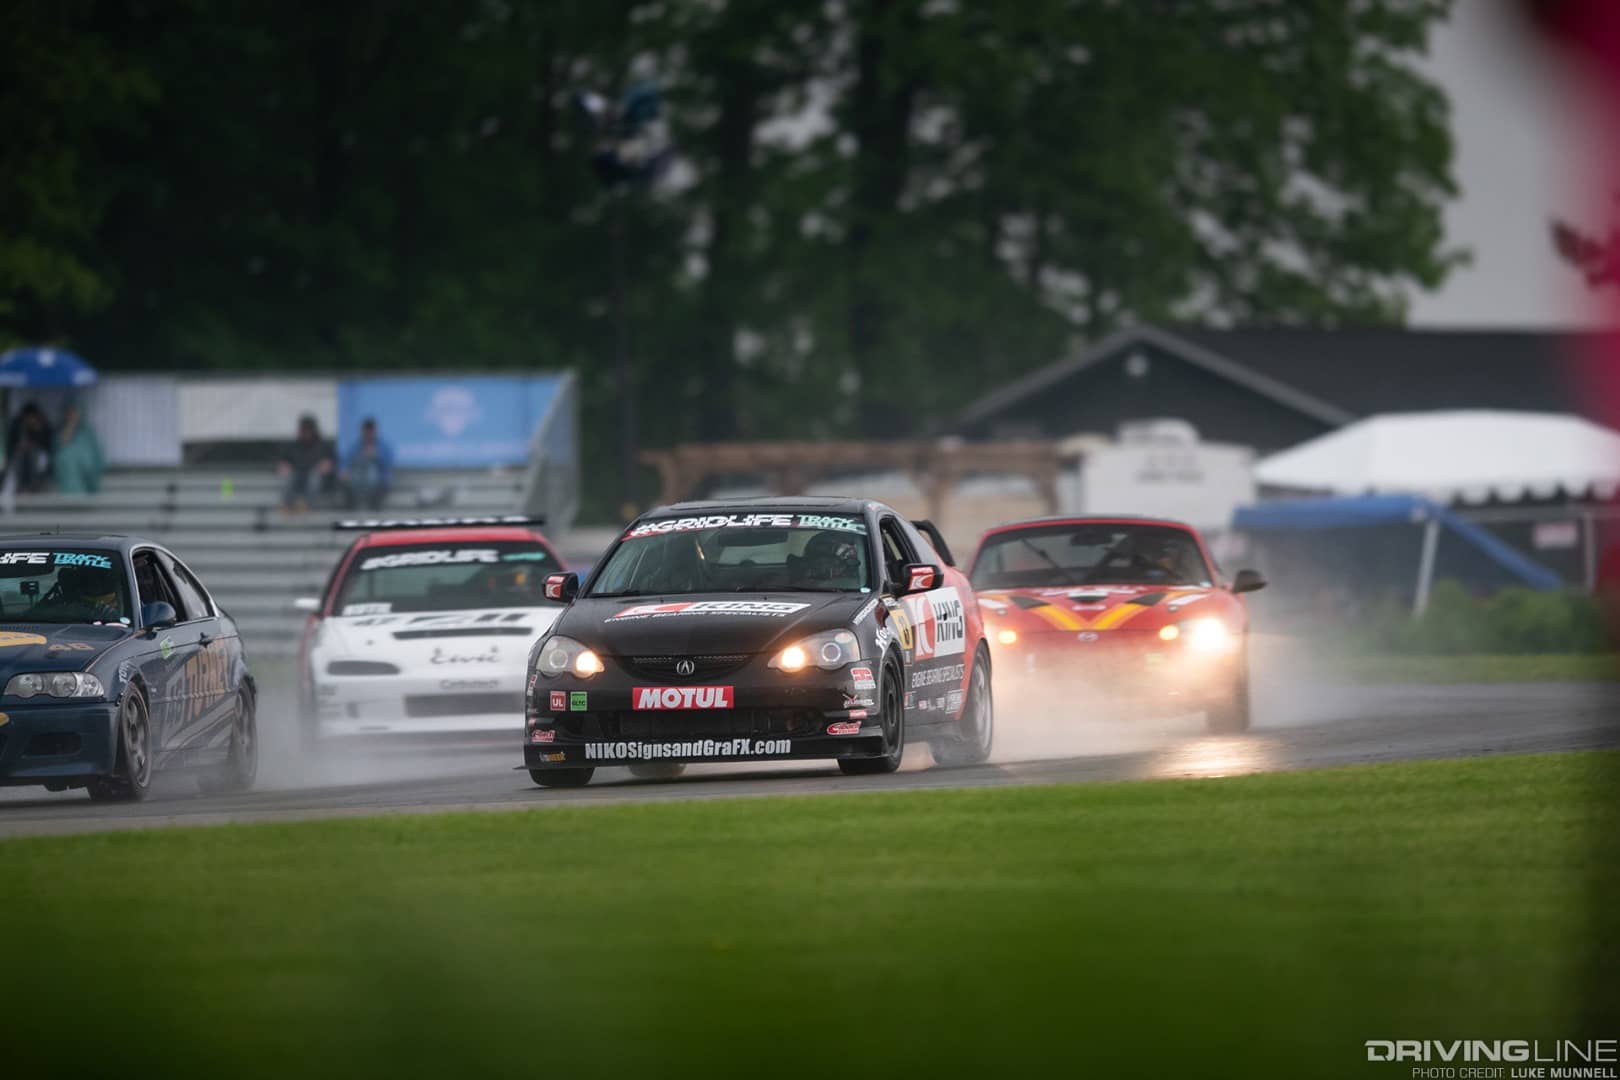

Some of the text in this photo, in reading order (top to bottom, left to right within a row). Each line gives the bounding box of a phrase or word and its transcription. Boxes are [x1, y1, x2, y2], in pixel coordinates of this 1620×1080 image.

[630, 514, 853, 537] #GRIDLIFE TRACK
[53, 552, 110, 562] TRACK
[694, 602, 793, 610] KING
[638, 687, 729, 709] MOTUL
[585, 738, 791, 760] NIKOSignsandGraFX.com
